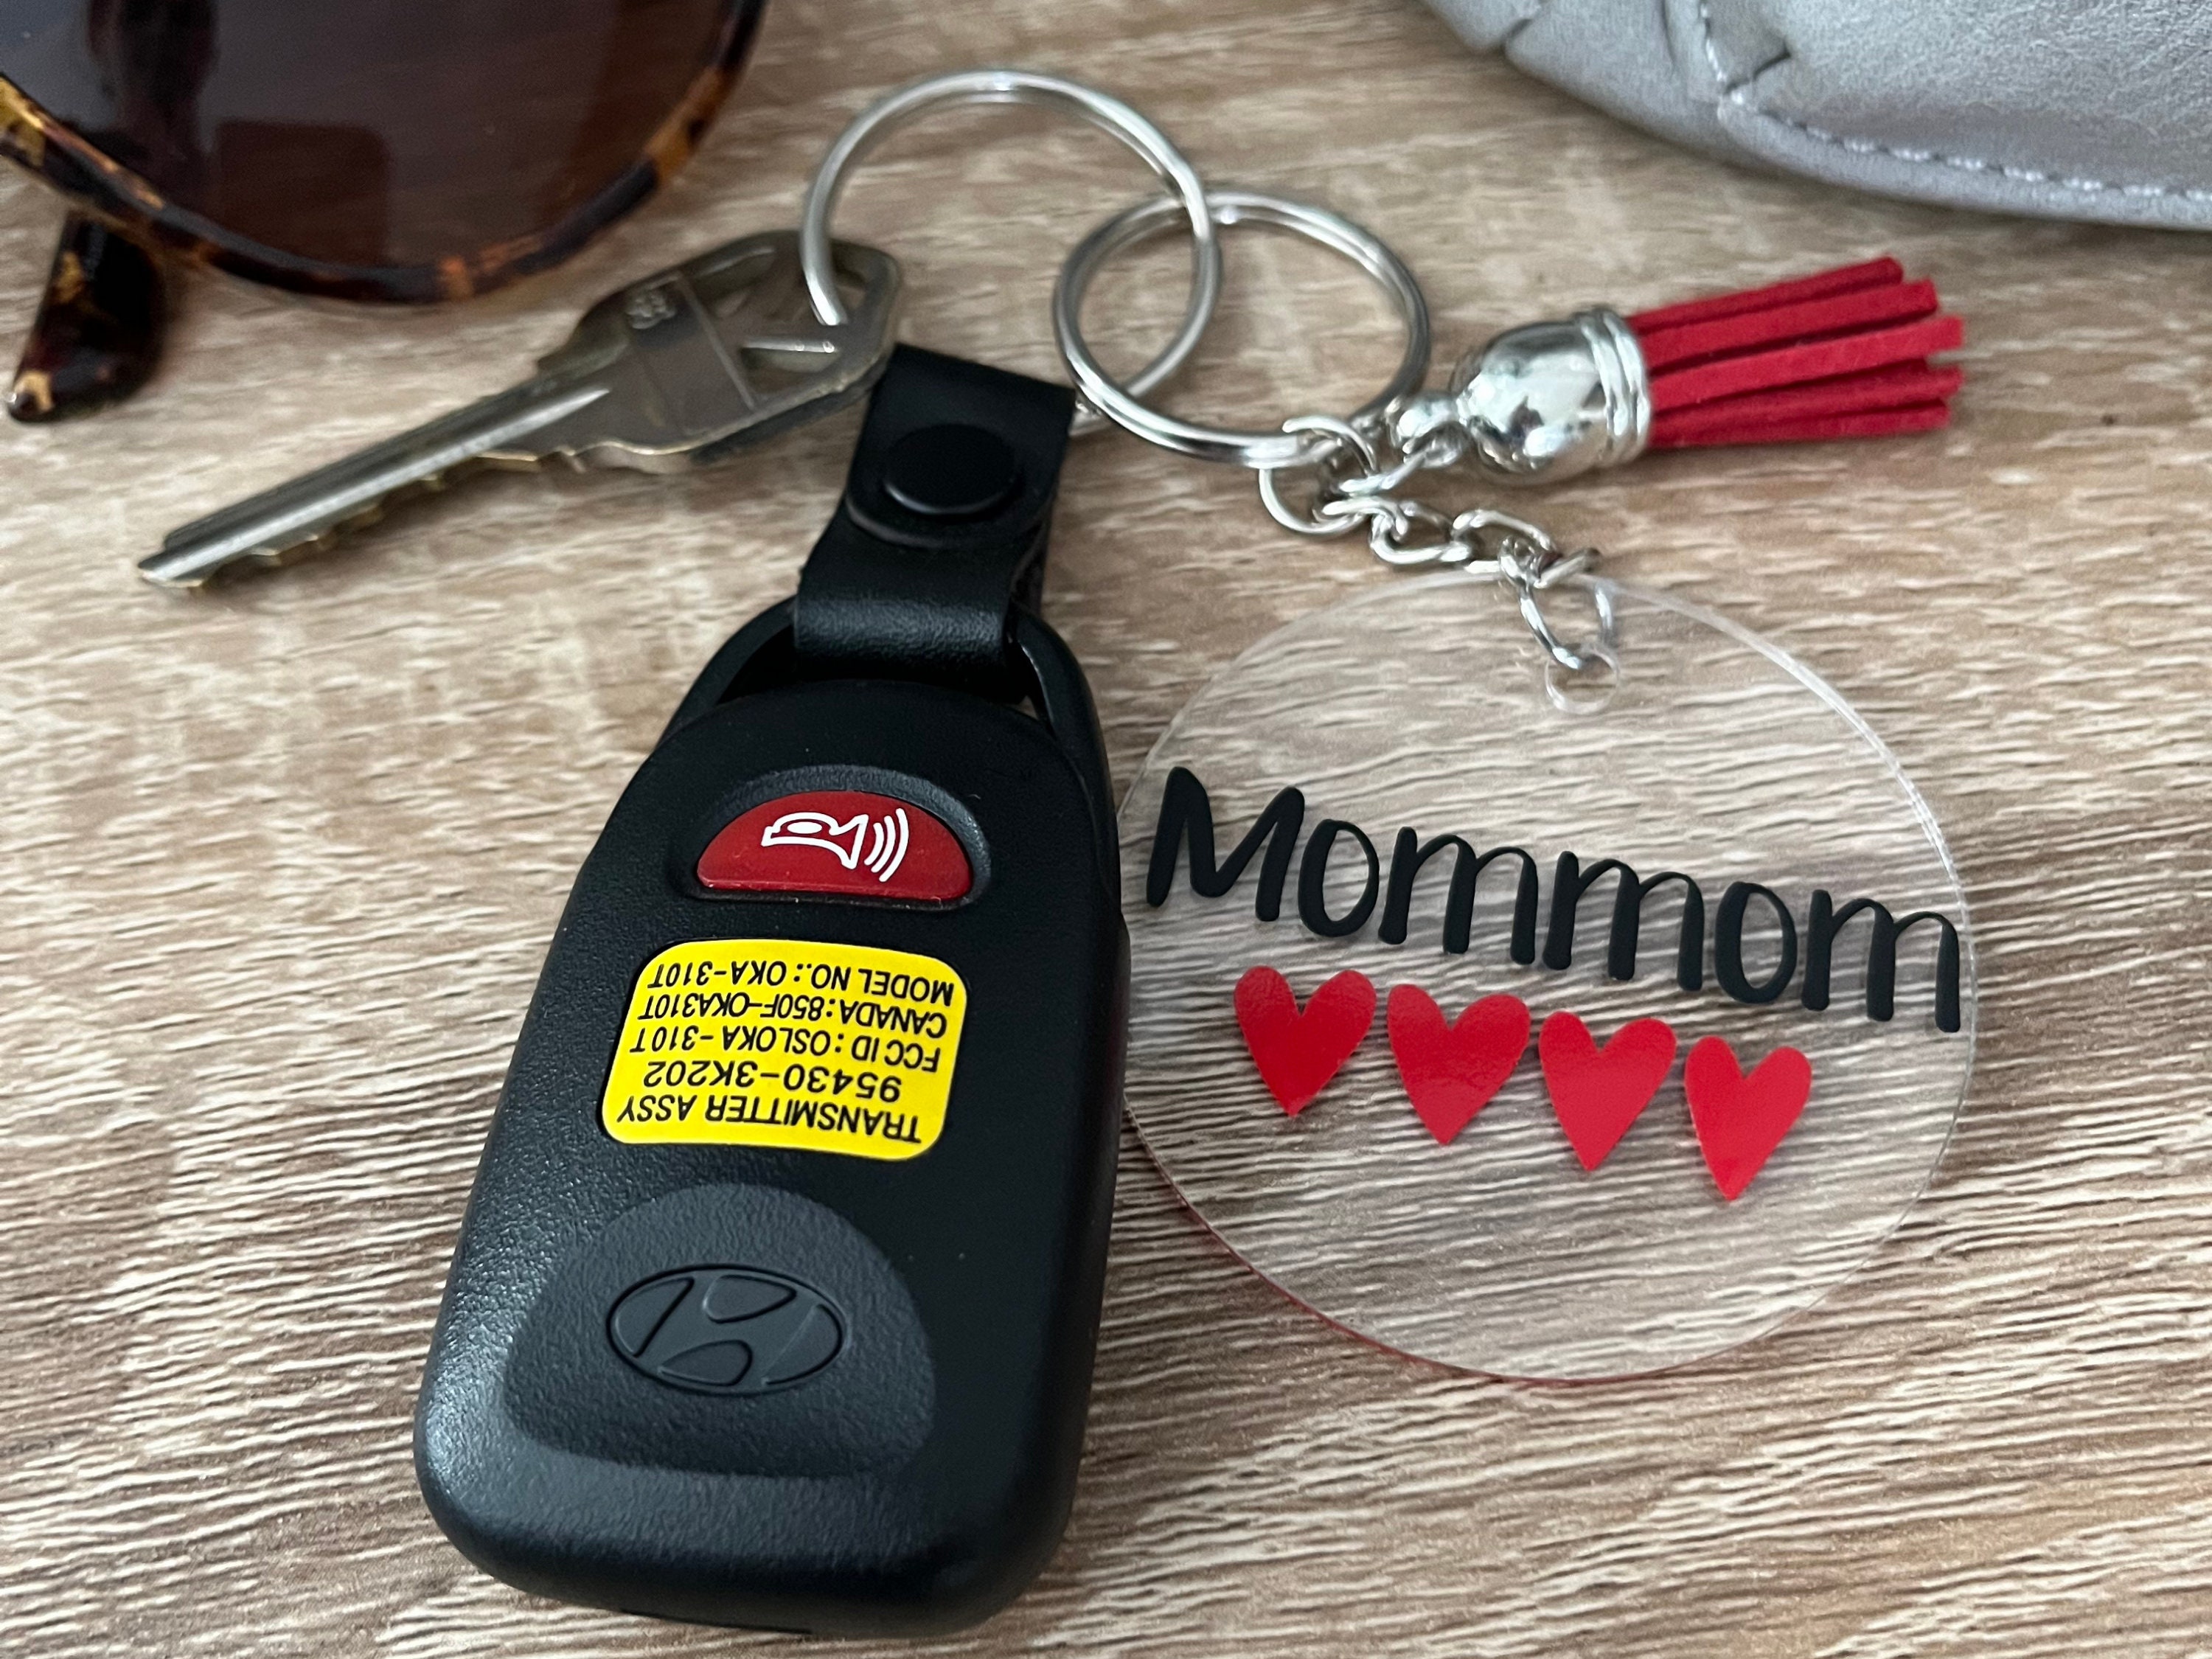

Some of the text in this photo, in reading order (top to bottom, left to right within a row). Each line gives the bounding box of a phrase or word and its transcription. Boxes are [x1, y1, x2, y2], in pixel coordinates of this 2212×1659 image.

[1146, 766, 1961, 1032] Mommom
[647, 960, 787, 989] OKA-310T
[858, 968, 954, 1007] MODEL
[884, 1040, 941, 1073] FCC
[643, 1060, 902, 1103] 95430-3K202
[616, 1094, 921, 1144] TRANSMITTER ASSY
